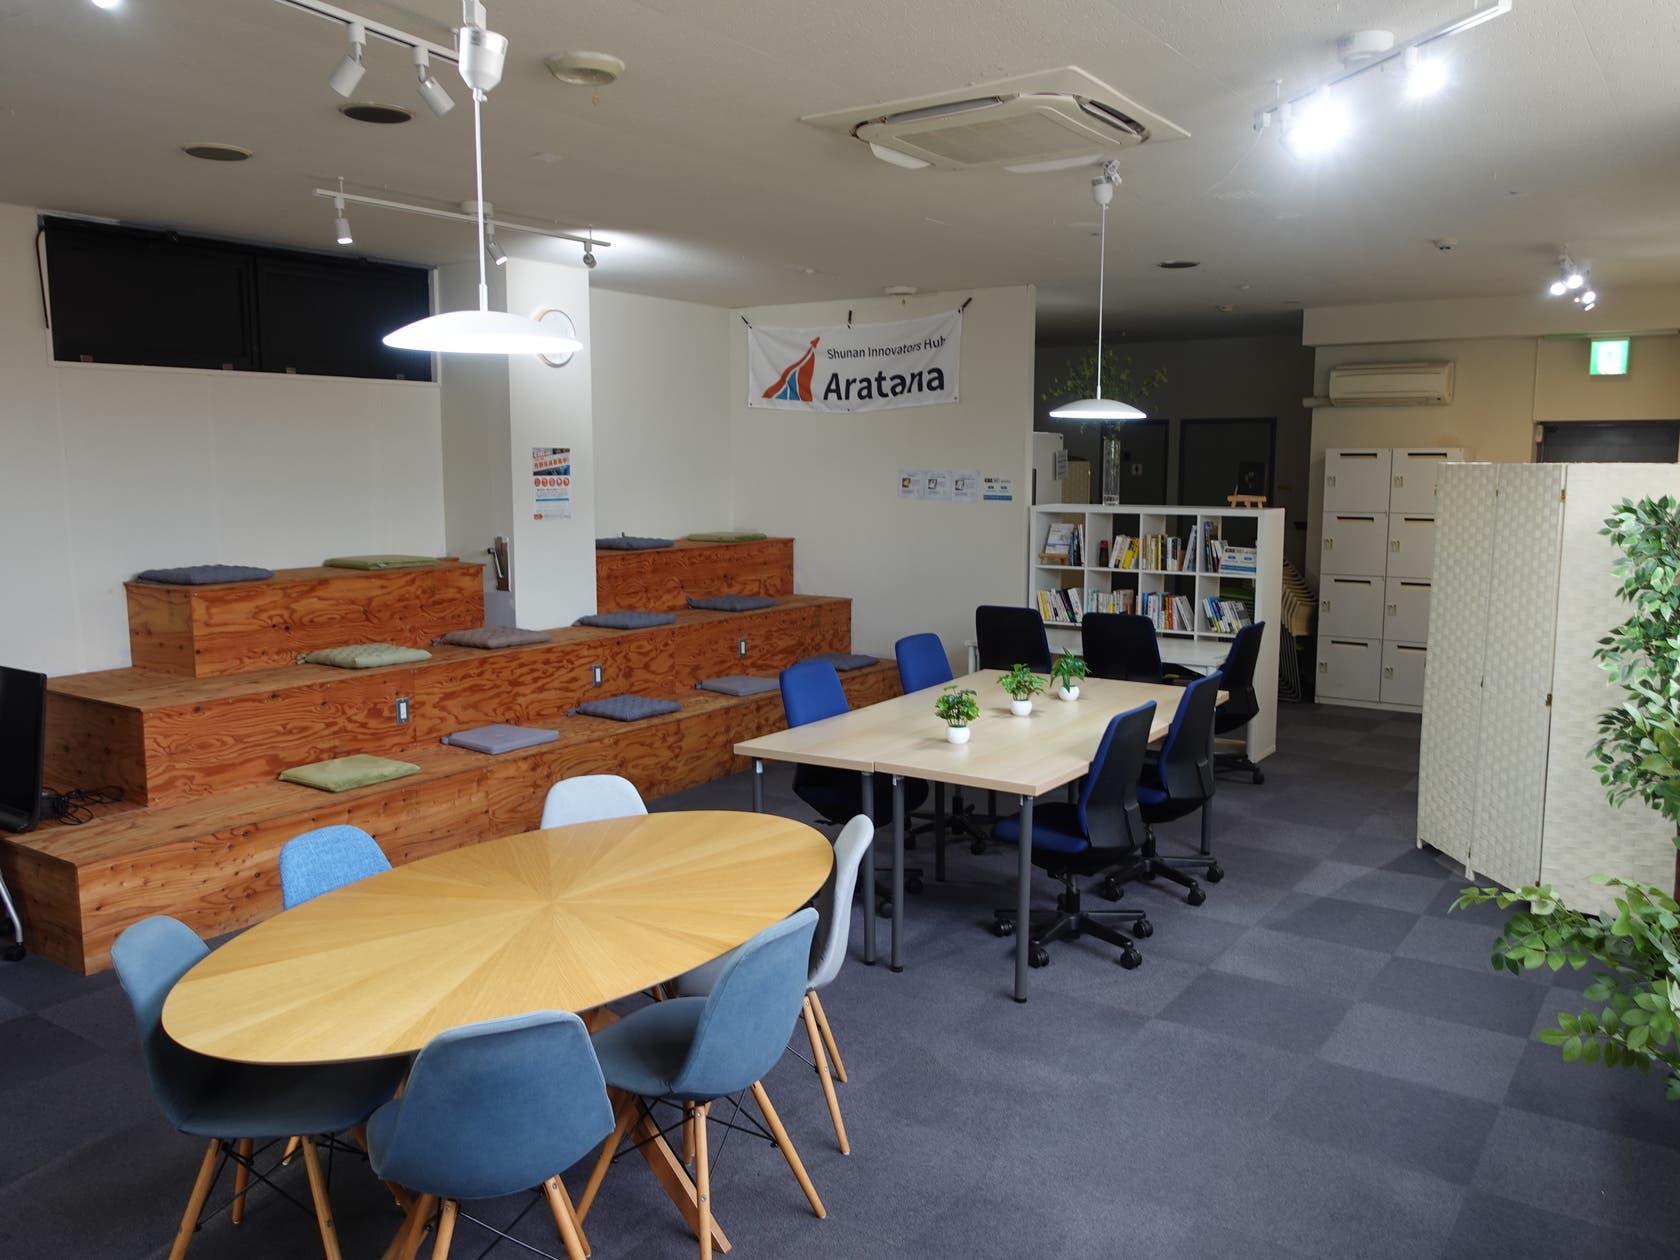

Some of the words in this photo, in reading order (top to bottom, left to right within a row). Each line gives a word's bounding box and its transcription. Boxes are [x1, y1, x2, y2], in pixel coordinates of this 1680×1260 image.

[827, 347, 865, 359] Shunan
[868, 342, 921, 357] Innovators
[823, 367, 945, 400] Aratana
